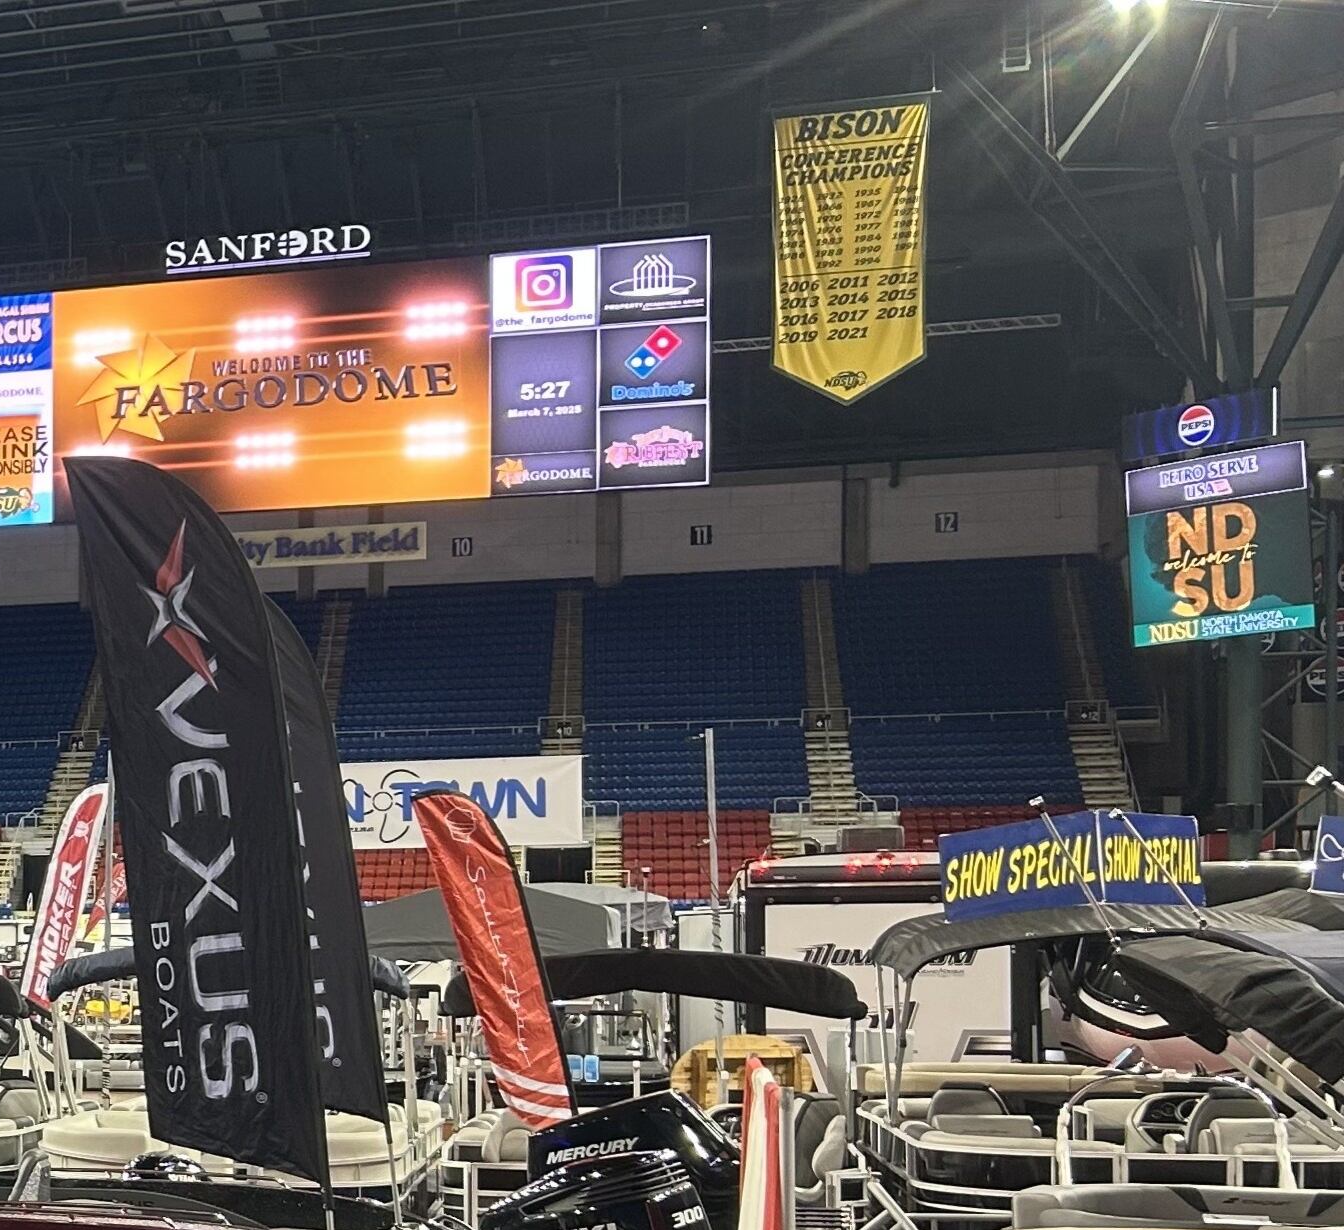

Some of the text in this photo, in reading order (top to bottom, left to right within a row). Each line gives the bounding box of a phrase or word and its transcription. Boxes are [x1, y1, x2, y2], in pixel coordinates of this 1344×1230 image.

[796, 108, 907, 143] BISON
[781, 143, 918, 171] CONFERENCE
[785, 161, 913, 187] CHAMPIONS
[165, 224, 371, 268] SANFORD
[780, 272, 918, 294] 2006 2011 2012
[780, 289, 917, 311] 2013 2014 2015
[779, 306, 917, 327] 2016 2017 2018
[779, 327, 868, 345] 2019 2021
[213, 348, 373, 377] WELCOME TO THE
[110, 363, 458, 419] FARGODOME
[520, 381, 571, 401] 5:27
[824, 376, 855, 389] NDSU
[507, 407, 541, 418] March
[1180, 418, 1212, 432] PEPSI
[1159, 455, 1258, 488] PETRO SERVE
[1185, 483, 1214, 500] USA
[274, 527, 419, 559] Bank Field
[1166, 501, 1257, 560] ND
[1164, 543, 1259, 573] welcome to
[1171, 562, 1256, 617] SU
[1149, 618, 1200, 644] NDSU
[1201, 610, 1285, 628] NORTH DAKOTA
[1201, 617, 1299, 637] STATE UNIVERSITY
[945, 832, 1098, 903] SHOW SPECIAL
[1104, 835, 1202, 885] SHOW SPECIAL
[154, 663, 259, 1099] VEXUS
[33, 859, 83, 999] SMOKER
[149, 921, 185, 1095] BOATS
[546, 1137, 639, 1165] MERCURY
[671, 1205, 704, 1229] 300
